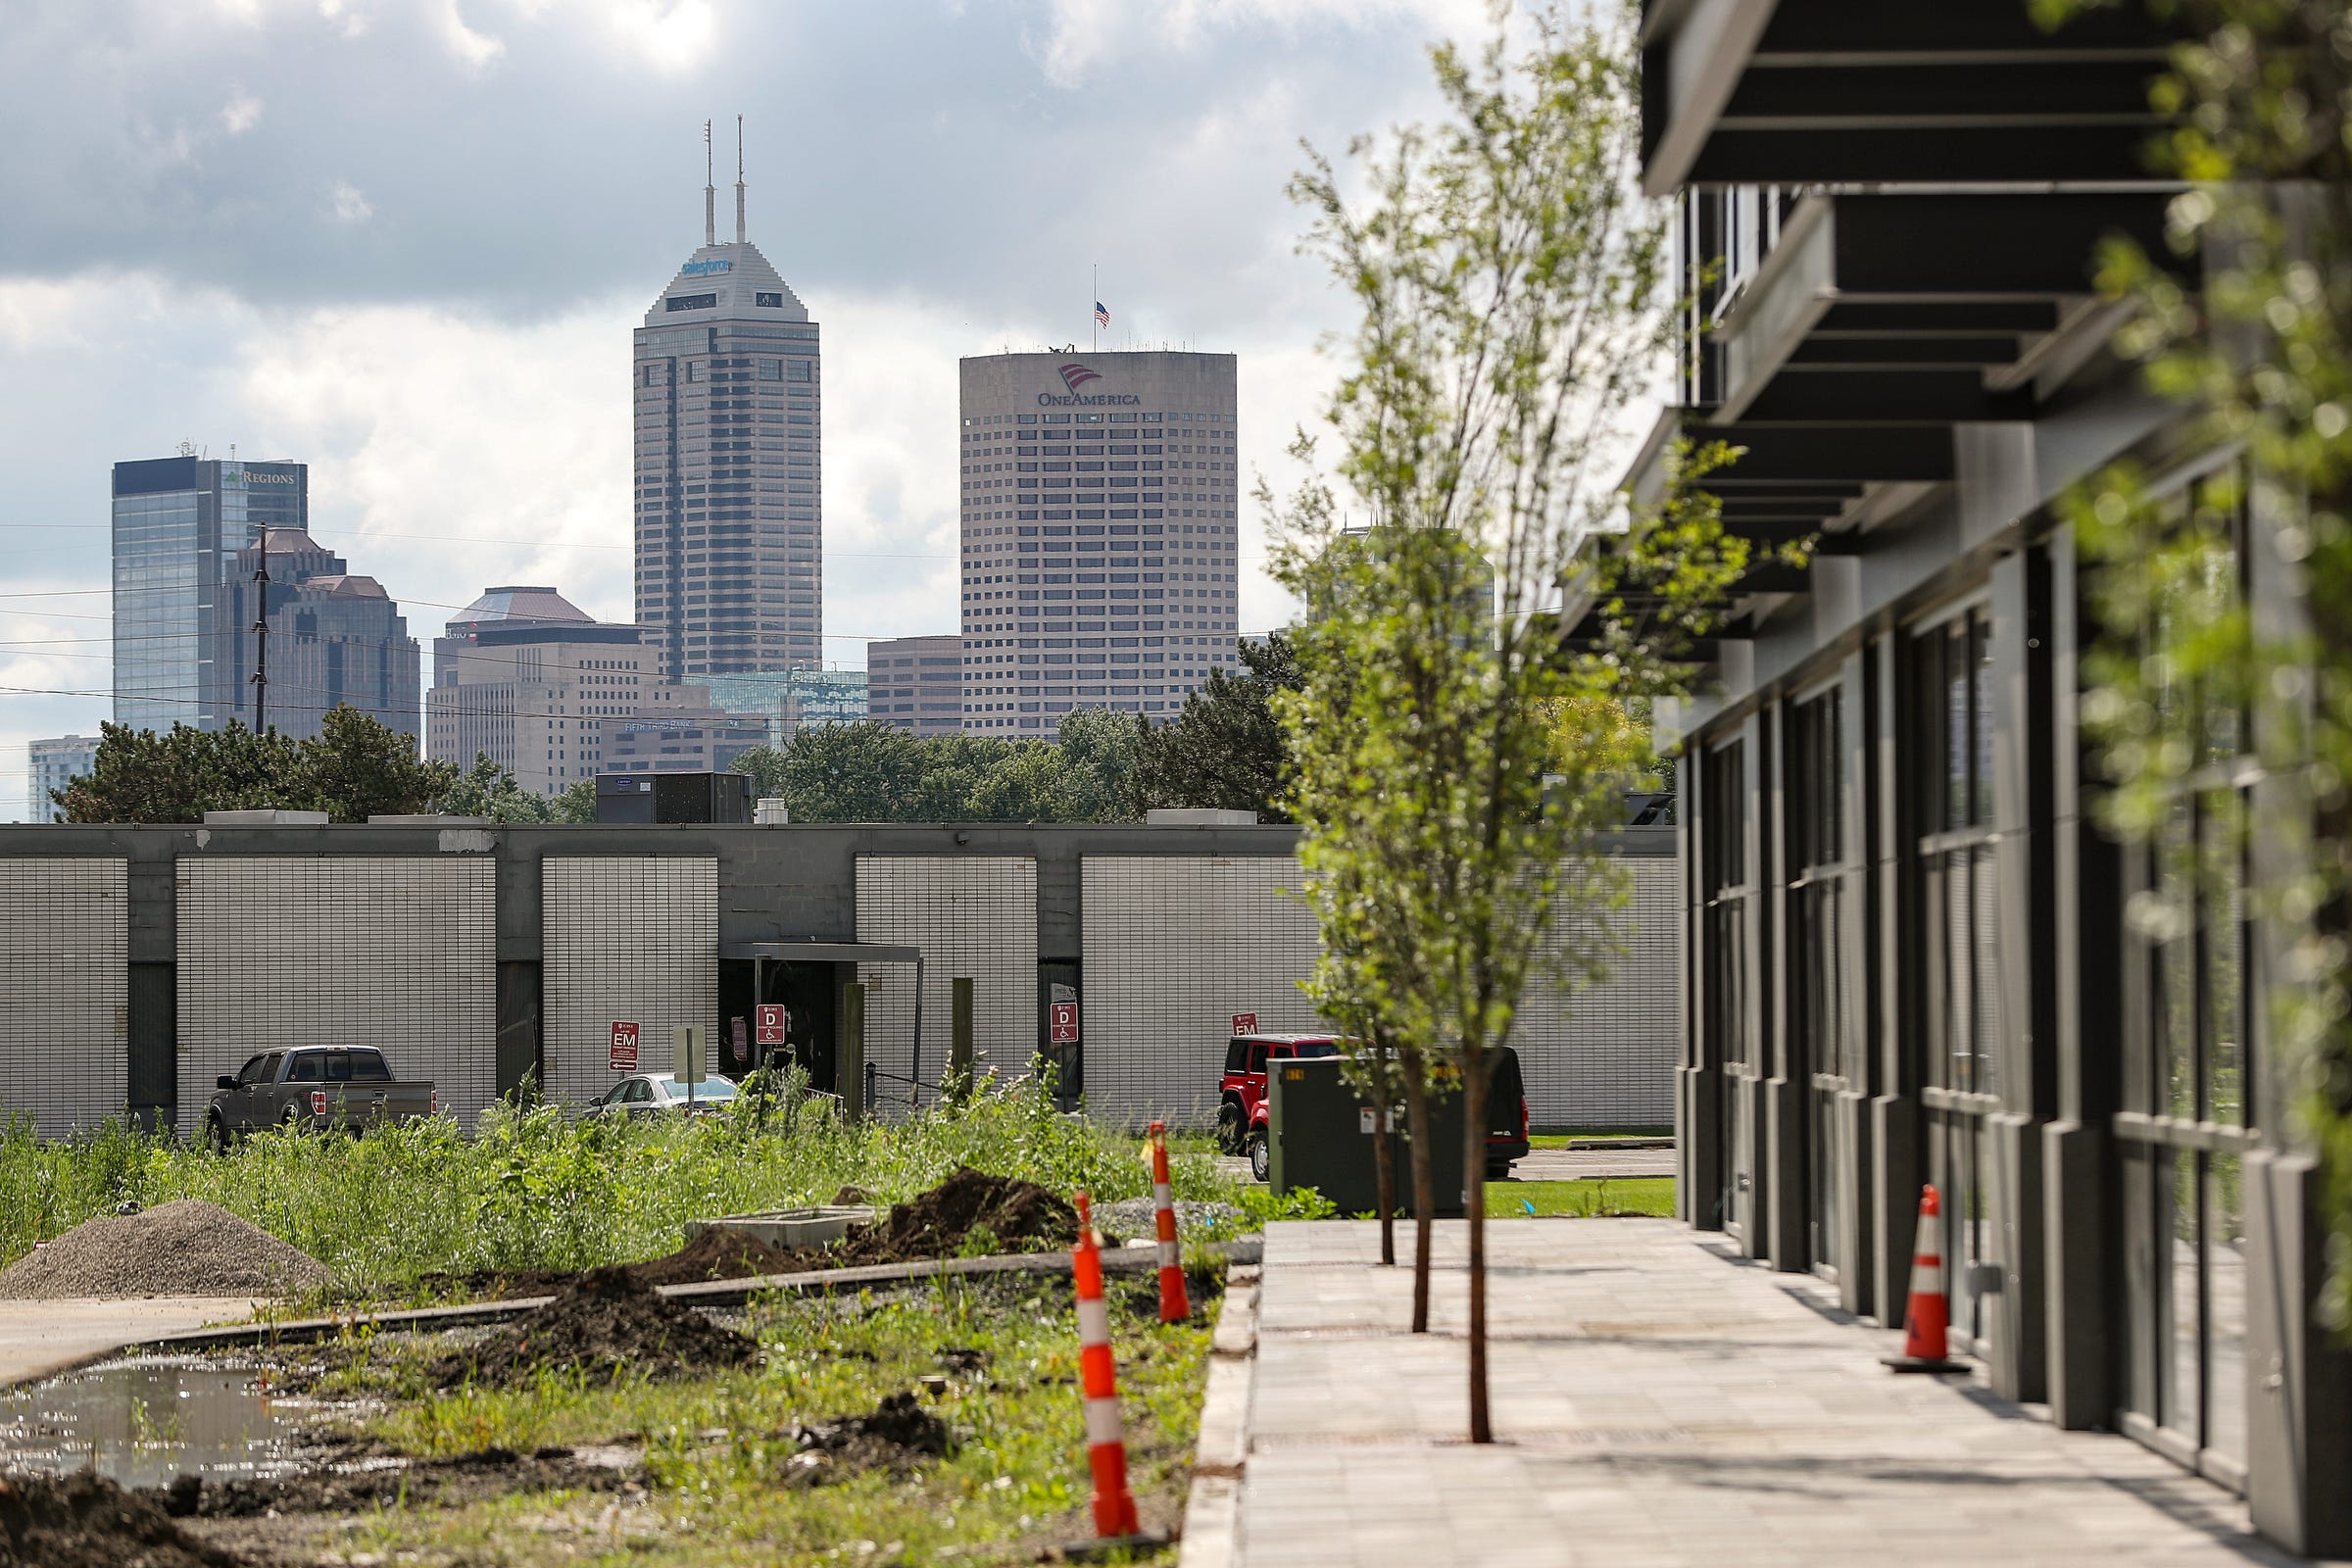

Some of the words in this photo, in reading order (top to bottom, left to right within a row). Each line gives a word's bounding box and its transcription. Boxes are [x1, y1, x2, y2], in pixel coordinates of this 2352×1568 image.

[765, 1013, 776, 1025] D
[1059, 1011, 1069, 1024] D
[613, 1033, 636, 1047] EM
